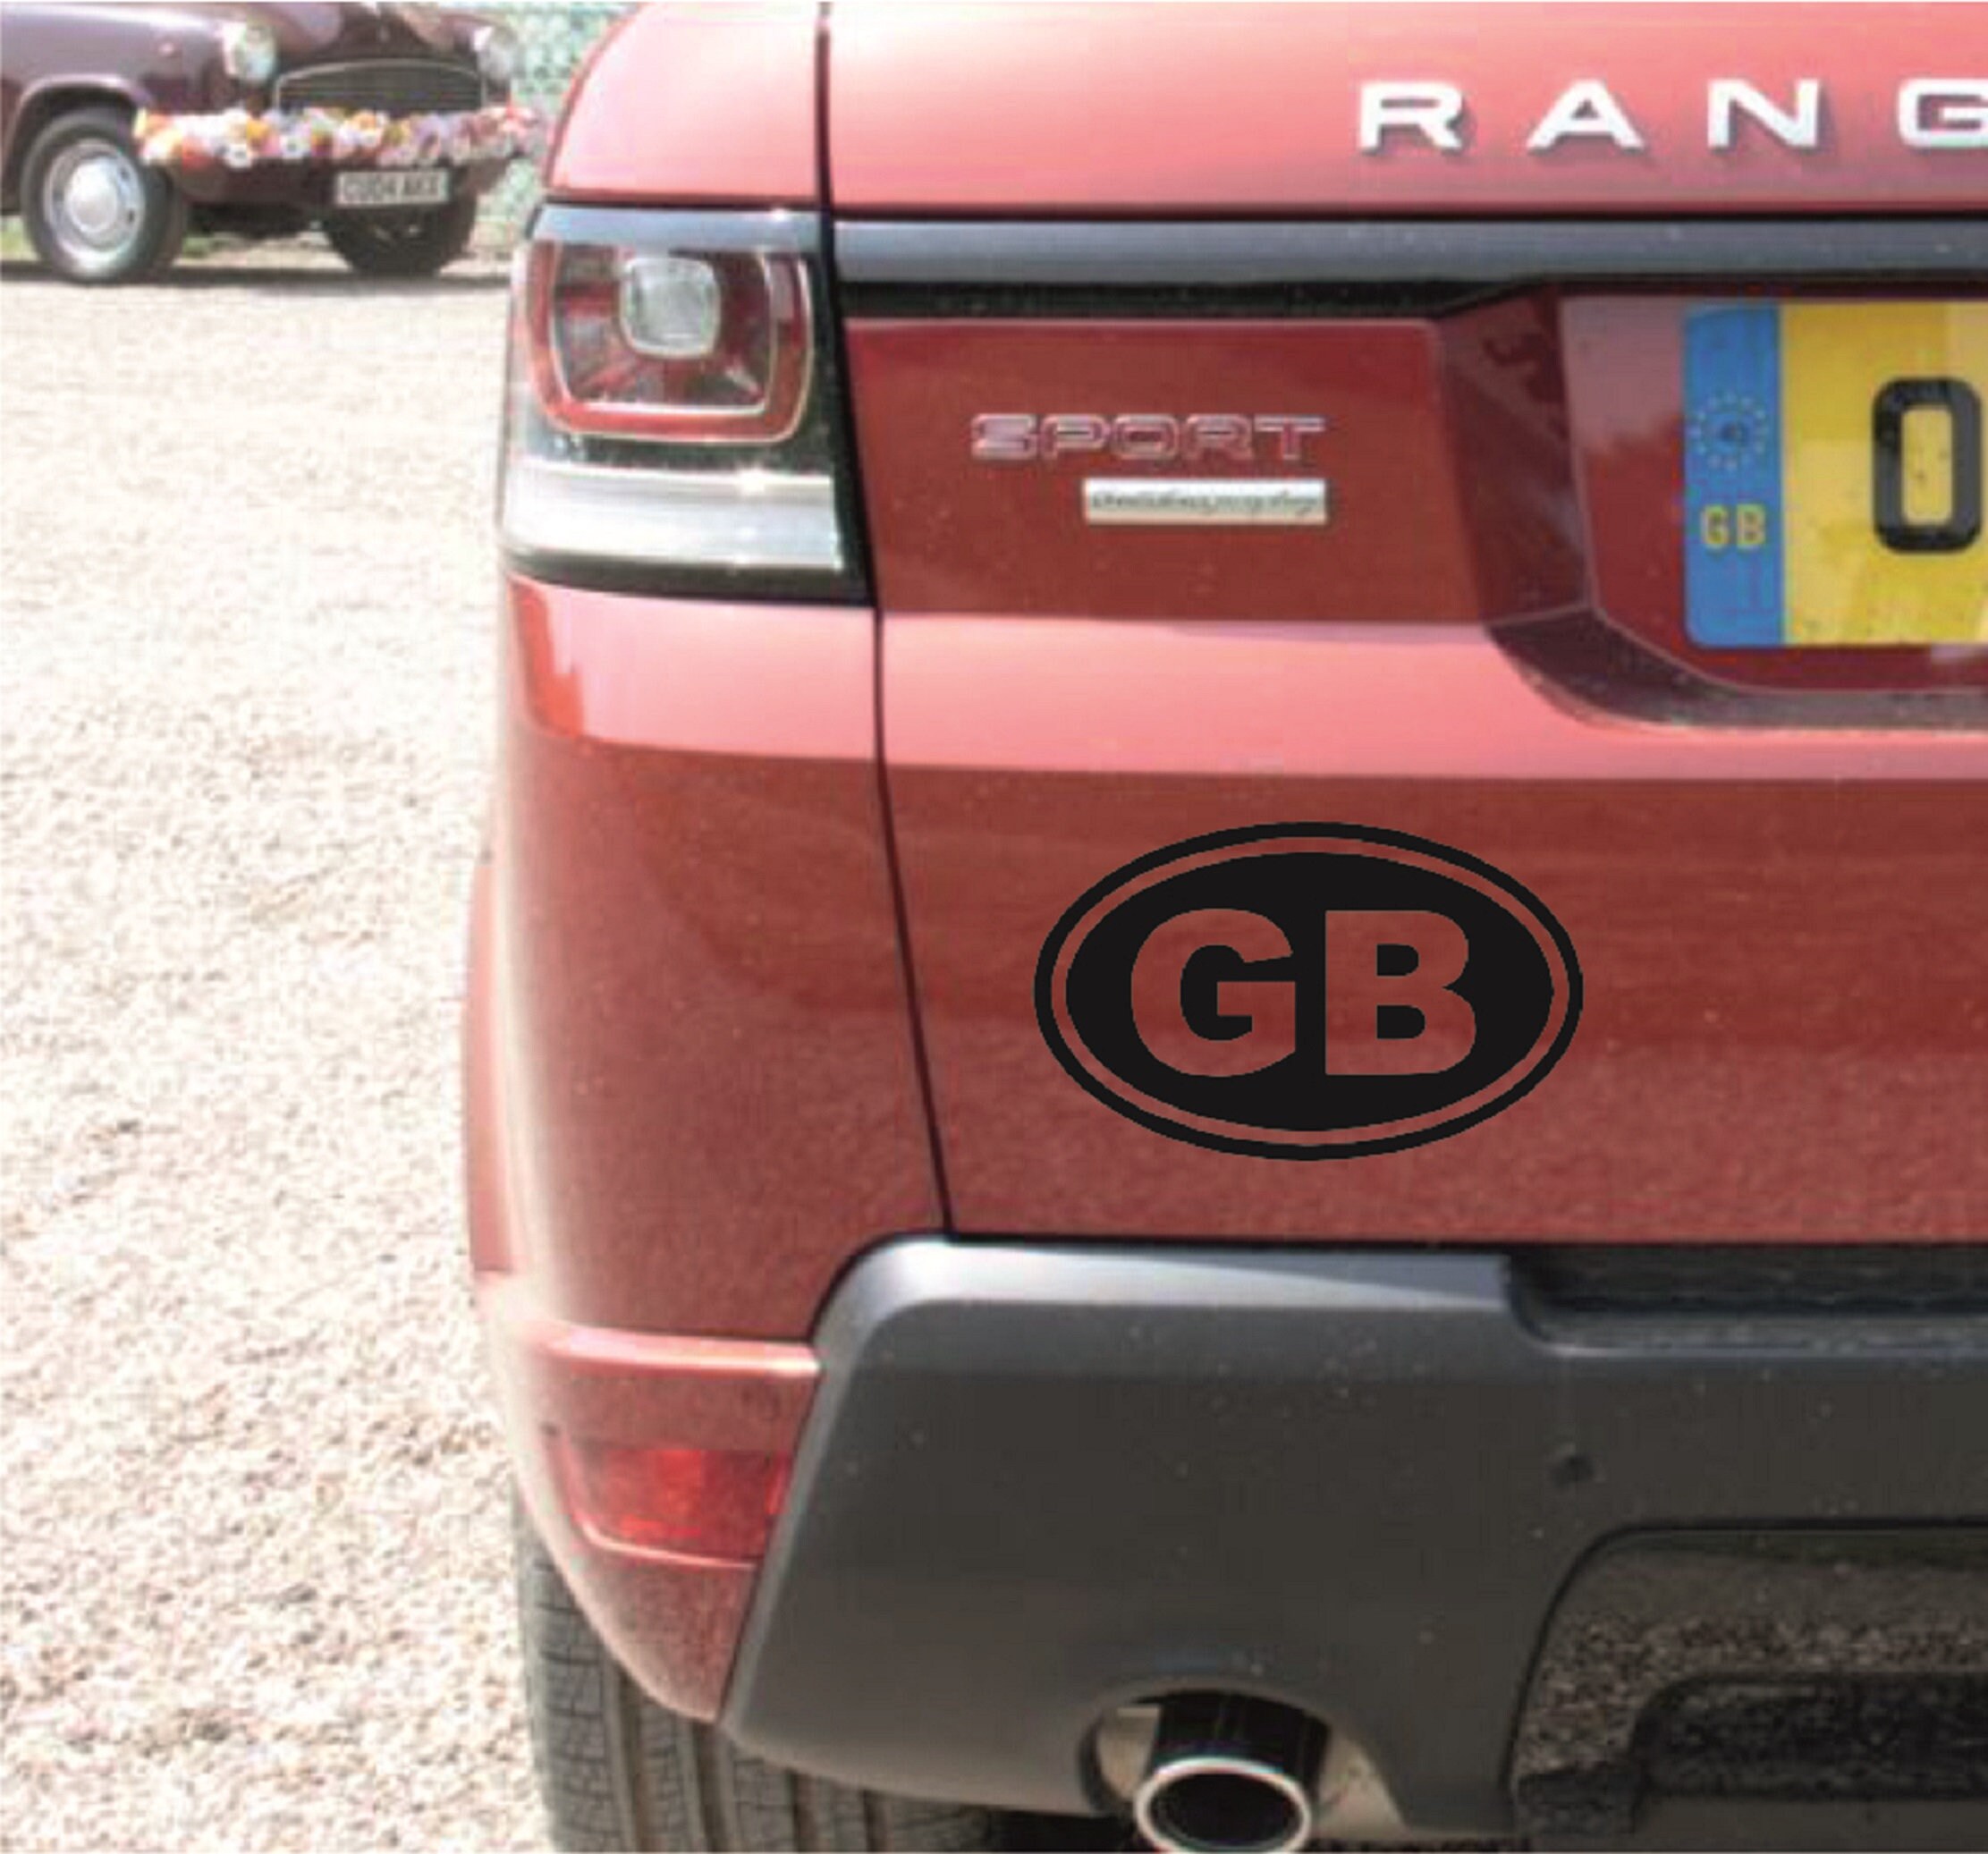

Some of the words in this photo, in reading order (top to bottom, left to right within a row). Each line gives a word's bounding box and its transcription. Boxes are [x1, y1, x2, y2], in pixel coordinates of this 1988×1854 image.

[1358, 77, 1988, 150] RANG
[969, 412, 1327, 462] SPORT
[1702, 503, 1766, 549] GB
[1129, 907, 1478, 1078] GB
